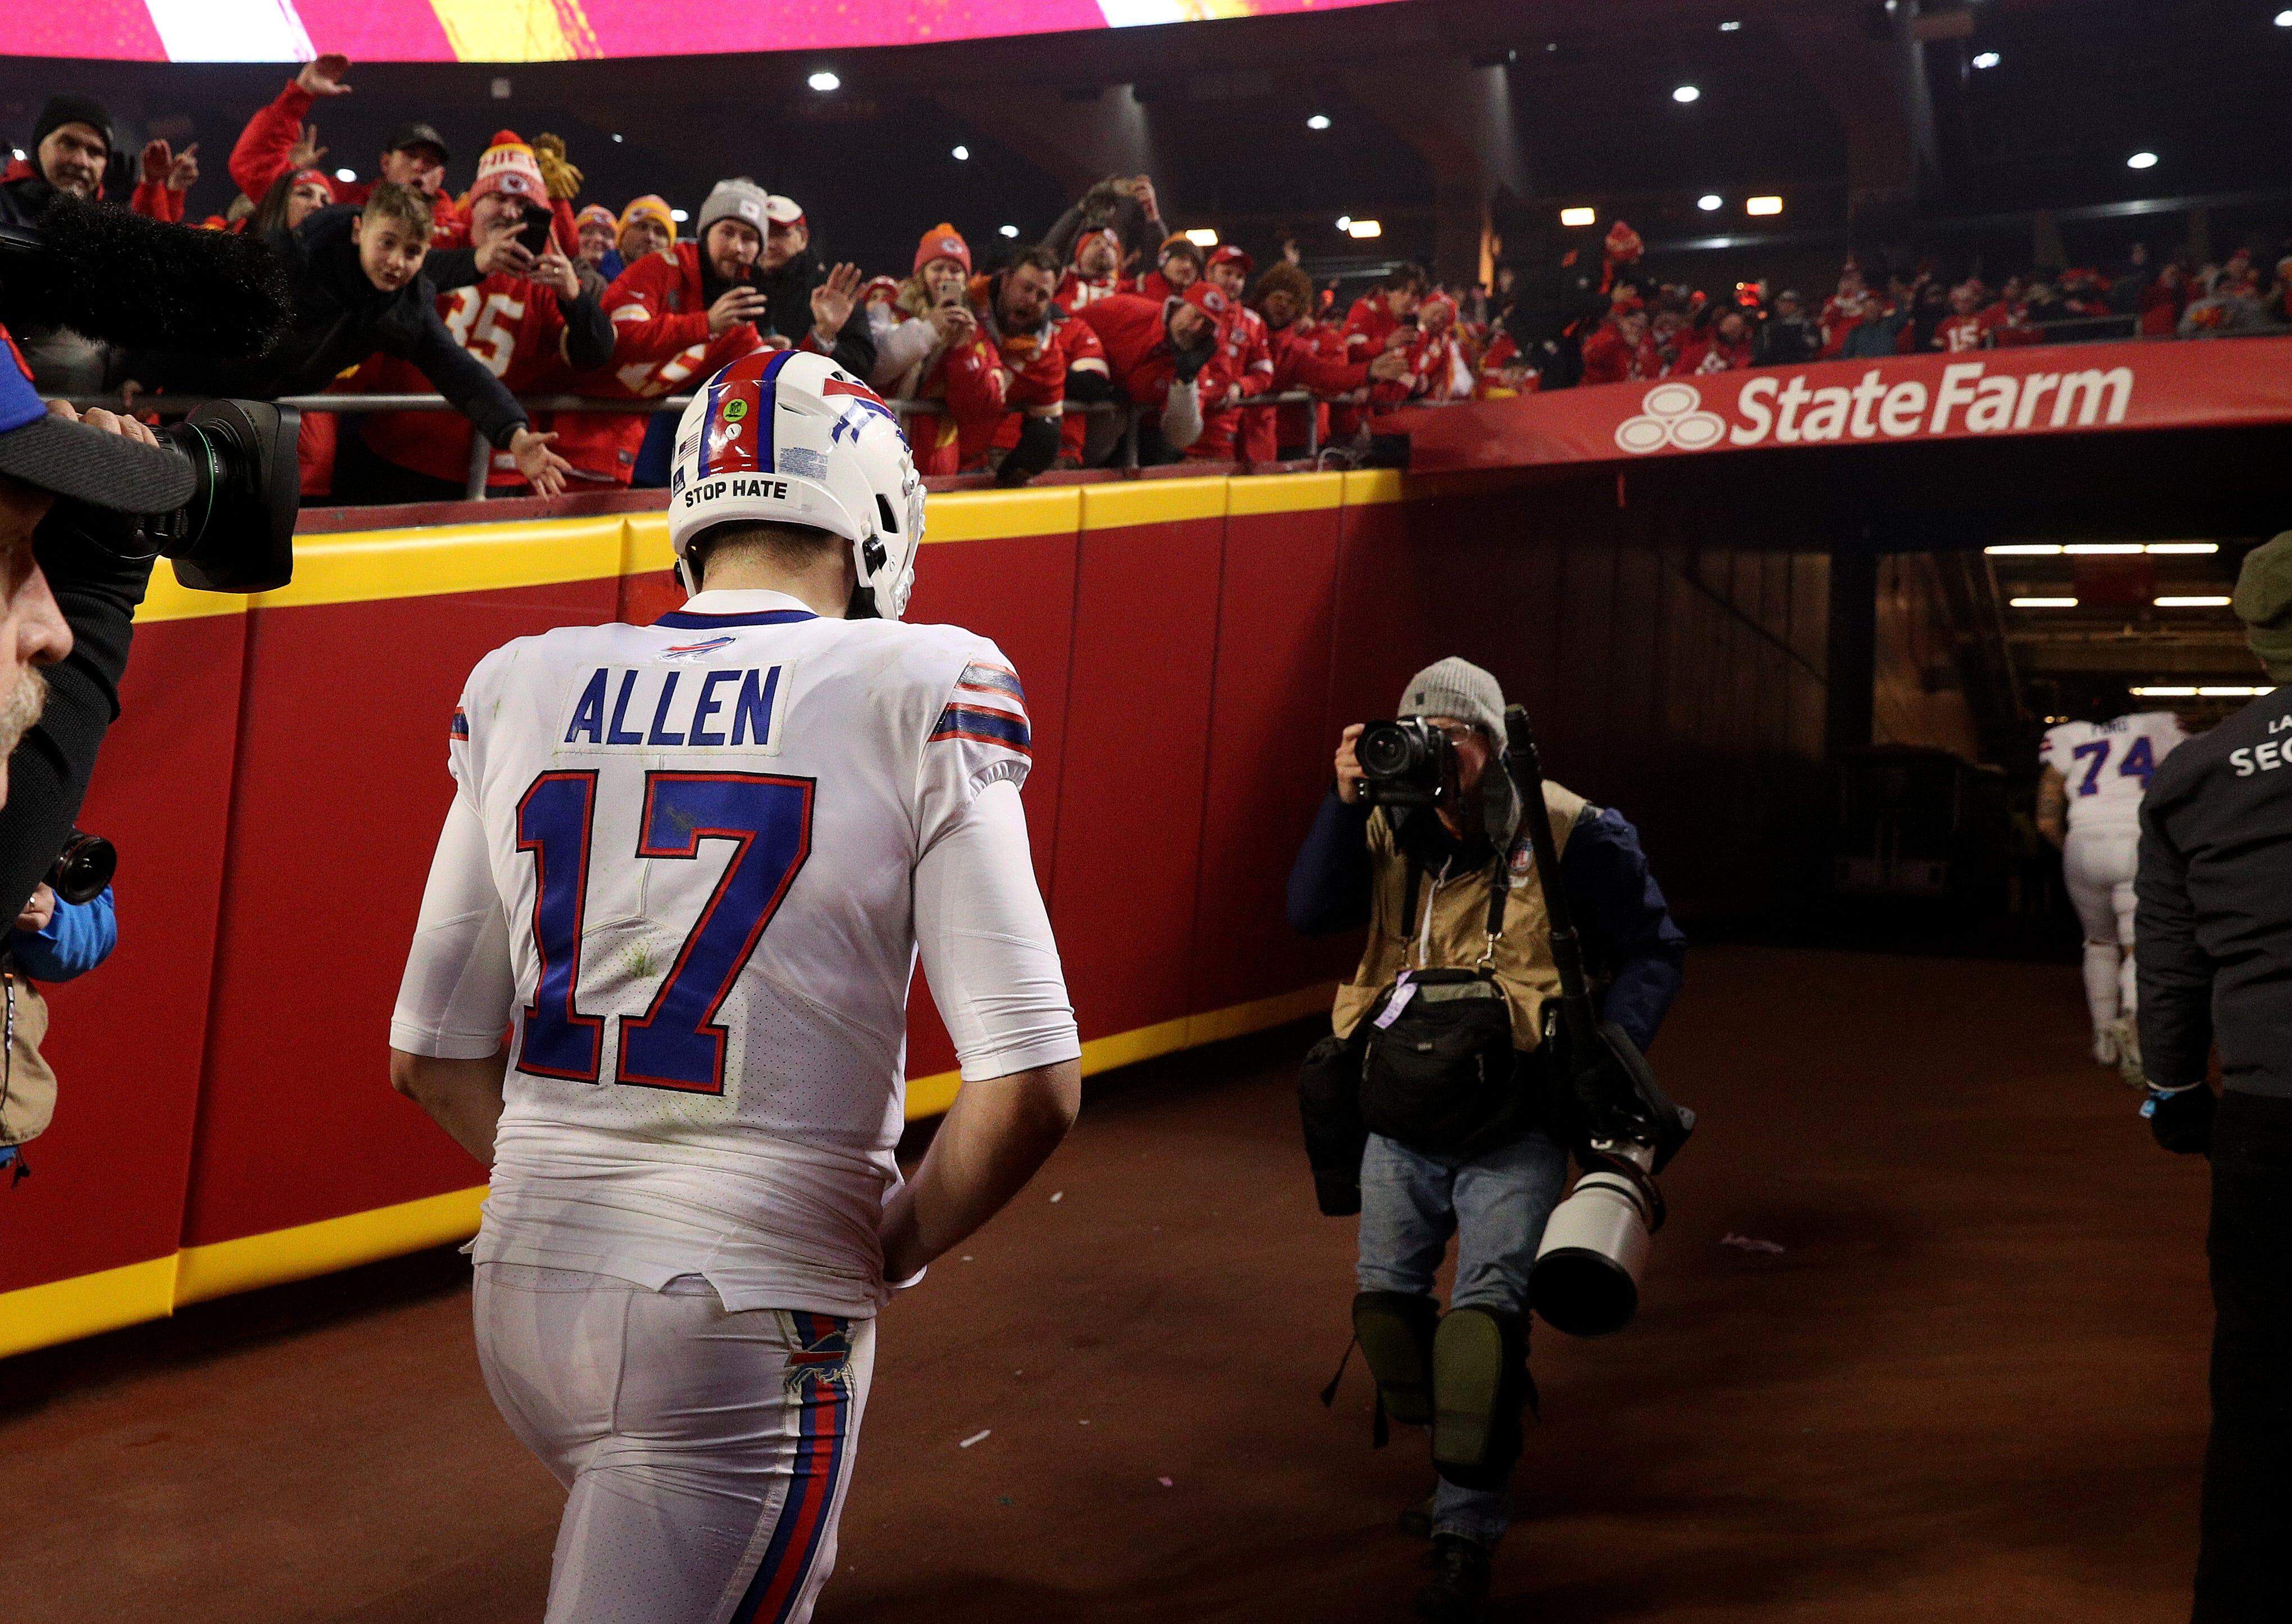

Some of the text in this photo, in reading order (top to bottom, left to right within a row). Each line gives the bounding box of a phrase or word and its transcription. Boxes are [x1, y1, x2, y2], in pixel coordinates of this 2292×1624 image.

[685, 481, 726, 508] STOP
[733, 479, 788, 499] HATE
[563, 665, 782, 746] ALLEN
[2073, 735, 2155, 797] 74
[515, 768, 817, 1097] 17
